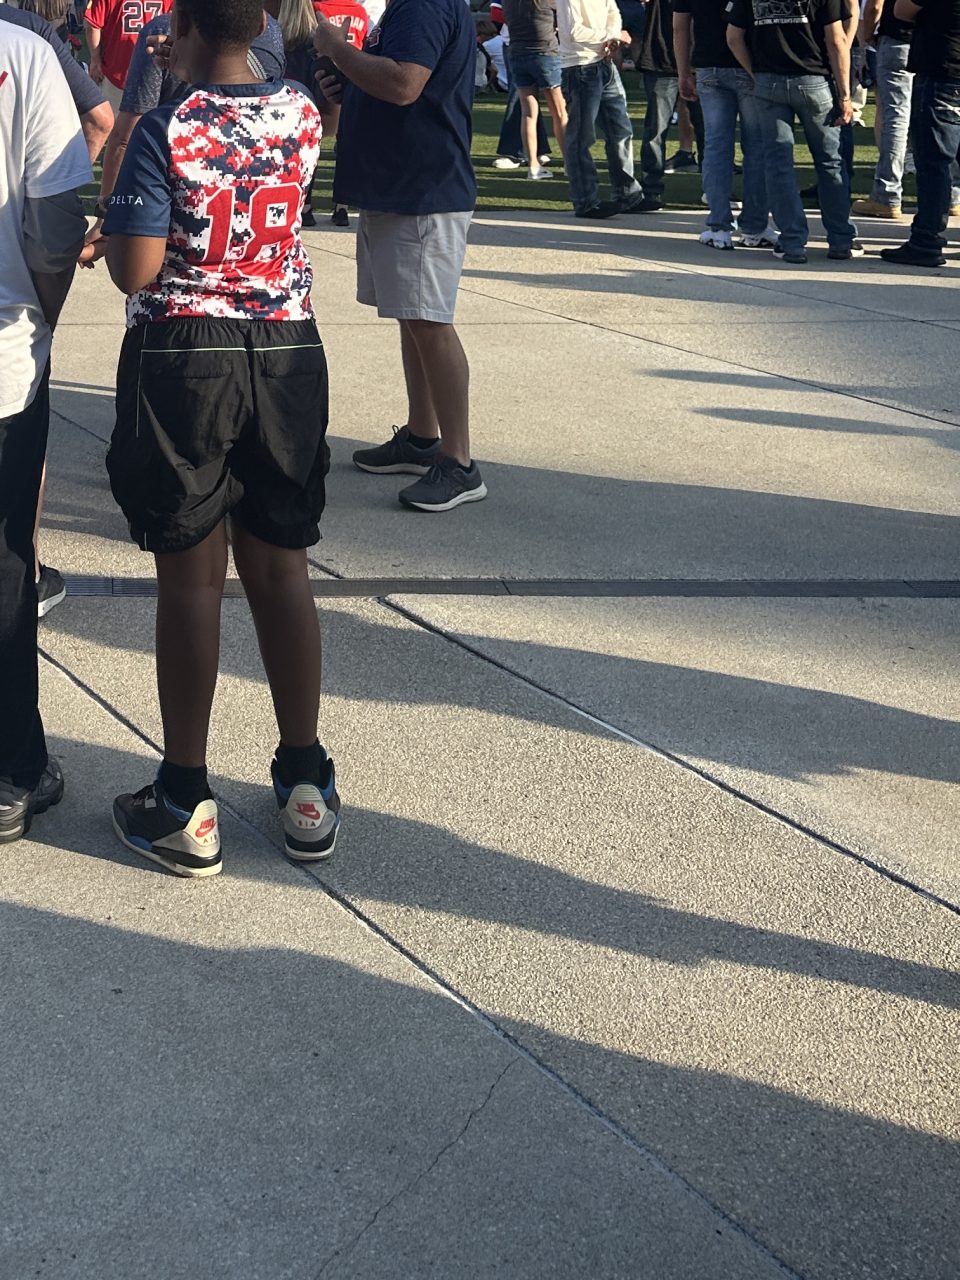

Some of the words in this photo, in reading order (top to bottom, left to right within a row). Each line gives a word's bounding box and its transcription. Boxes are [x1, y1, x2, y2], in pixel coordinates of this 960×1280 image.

[122, 0, 163, 35] 27
[110, 195, 144, 206] DELTA
[201, 181, 303, 277] 18
